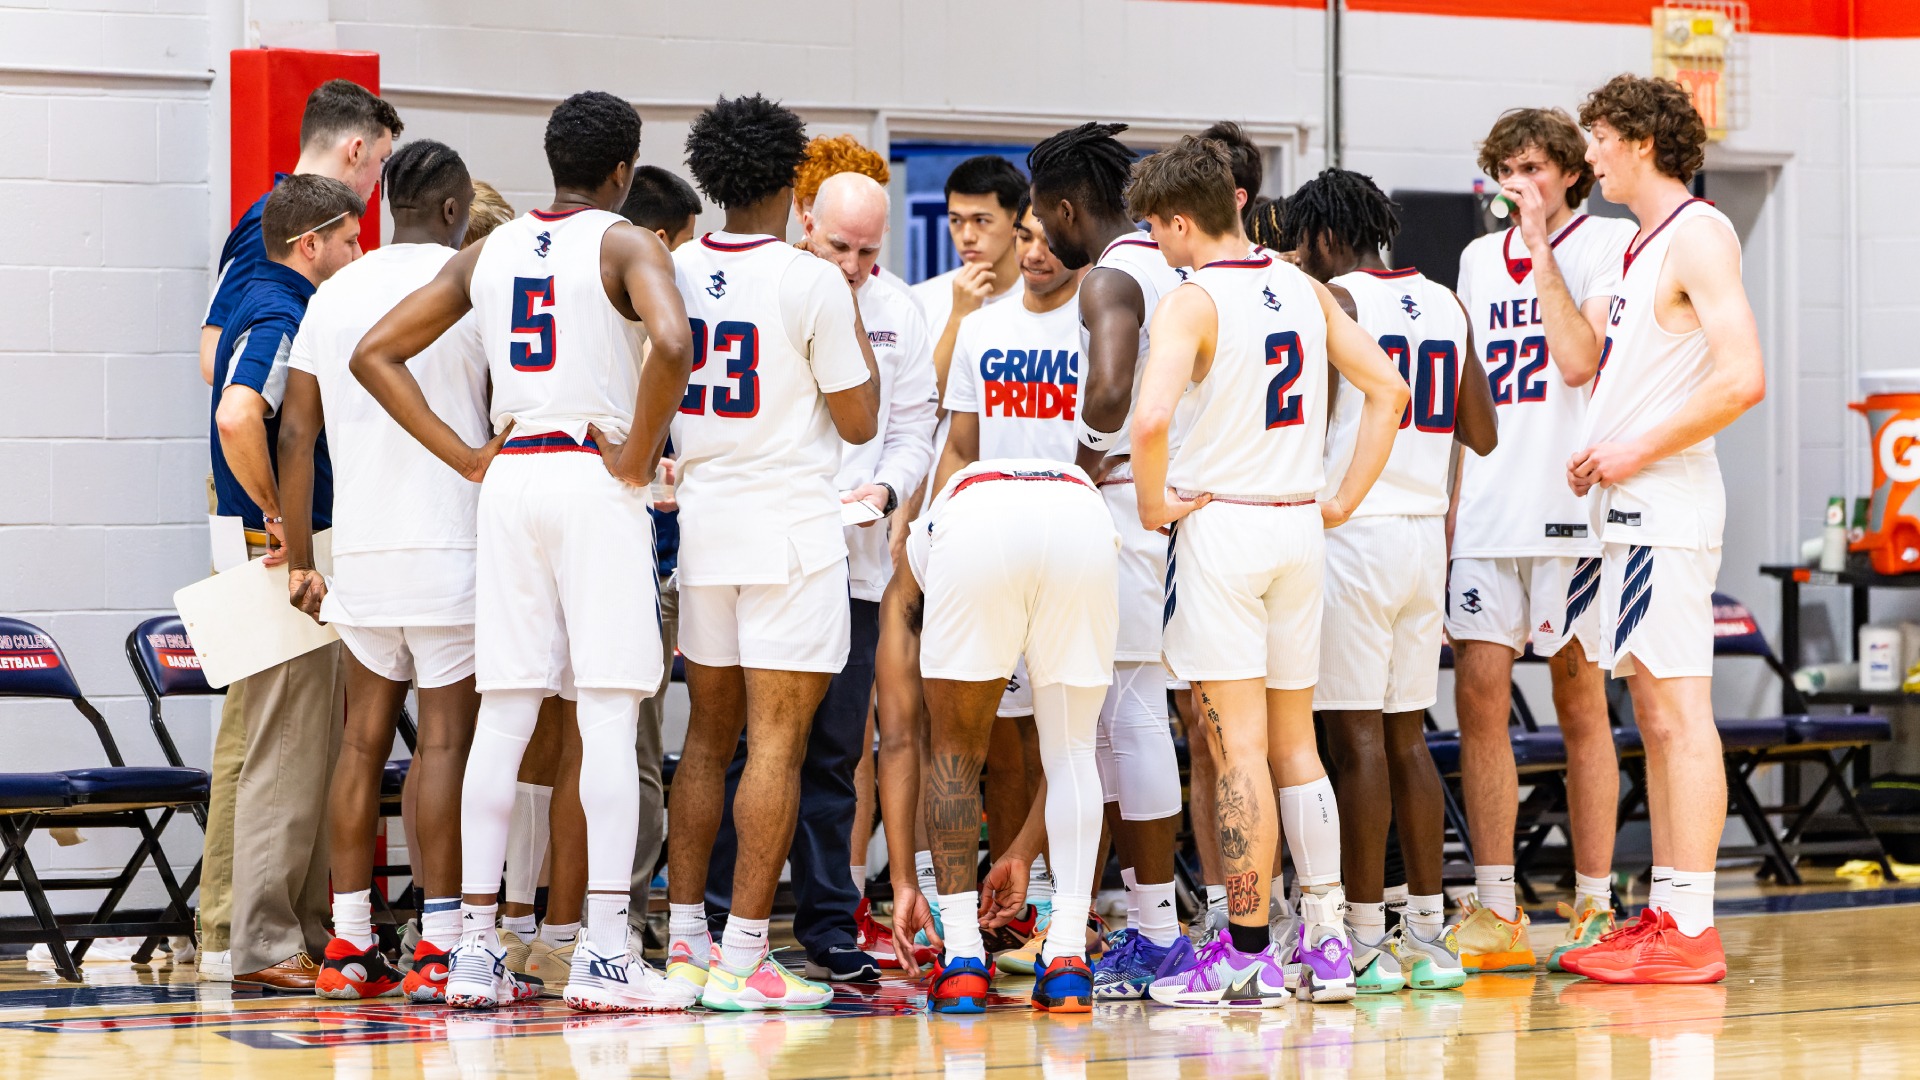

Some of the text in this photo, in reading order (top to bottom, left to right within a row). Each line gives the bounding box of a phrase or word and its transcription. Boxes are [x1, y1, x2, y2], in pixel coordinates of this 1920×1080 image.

[510, 275, 557, 372] 5
[1489, 298, 1543, 330] NEC
[867, 331, 897, 343] NEC
[1265, 331, 1305, 431] 2
[1486, 336, 1549, 406] 22
[985, 381, 1077, 421] PRIDE
[1879, 418, 1920, 483] G
[0, 656, 48, 668] ETBALL
[166, 655, 201, 668] BASKE
[1226, 871, 1259, 897] FEAR
[1228, 896, 1261, 916] NONE
[963, 960, 971, 968] 12
[1064, 959, 1073, 967] 12
